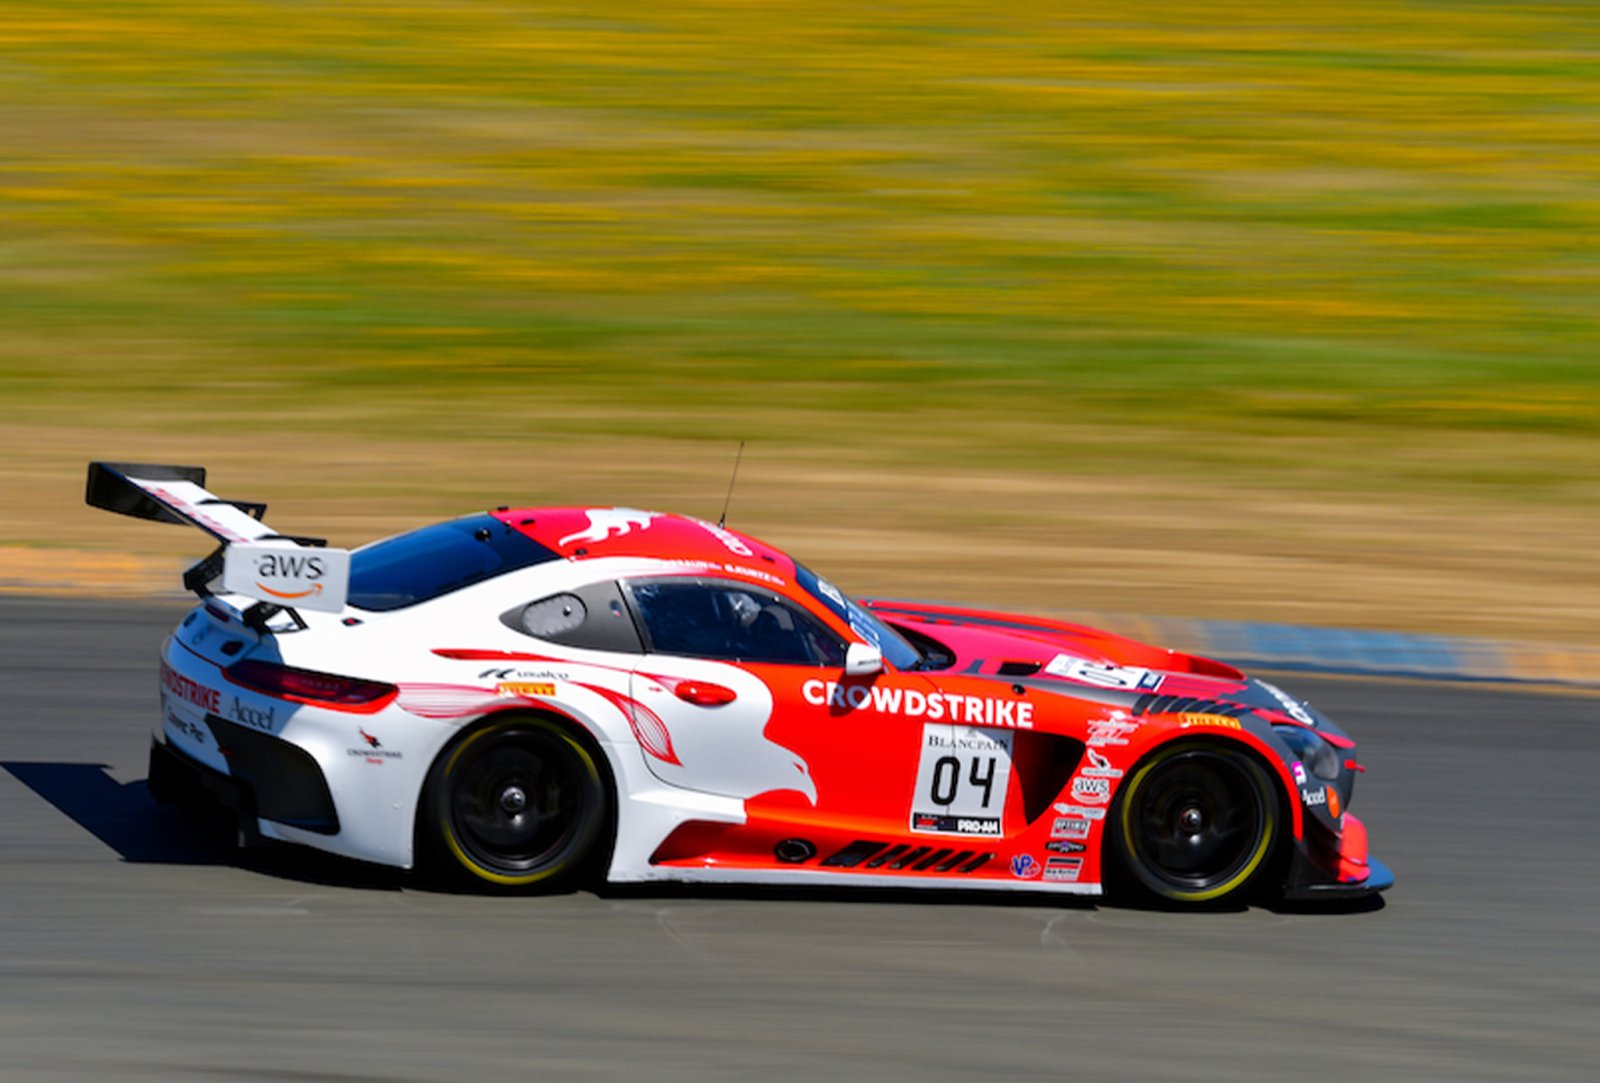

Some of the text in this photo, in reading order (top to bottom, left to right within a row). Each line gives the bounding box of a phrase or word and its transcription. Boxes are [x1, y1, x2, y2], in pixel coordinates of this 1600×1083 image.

[259, 554, 323, 580] aws
[229, 696, 274, 731] Accel
[802, 679, 1033, 728] CROWDSTRIKE
[931, 756, 996, 808] 04
[1074, 778, 1108, 793] aws
[957, 819, 998, 834] PRO-AM
